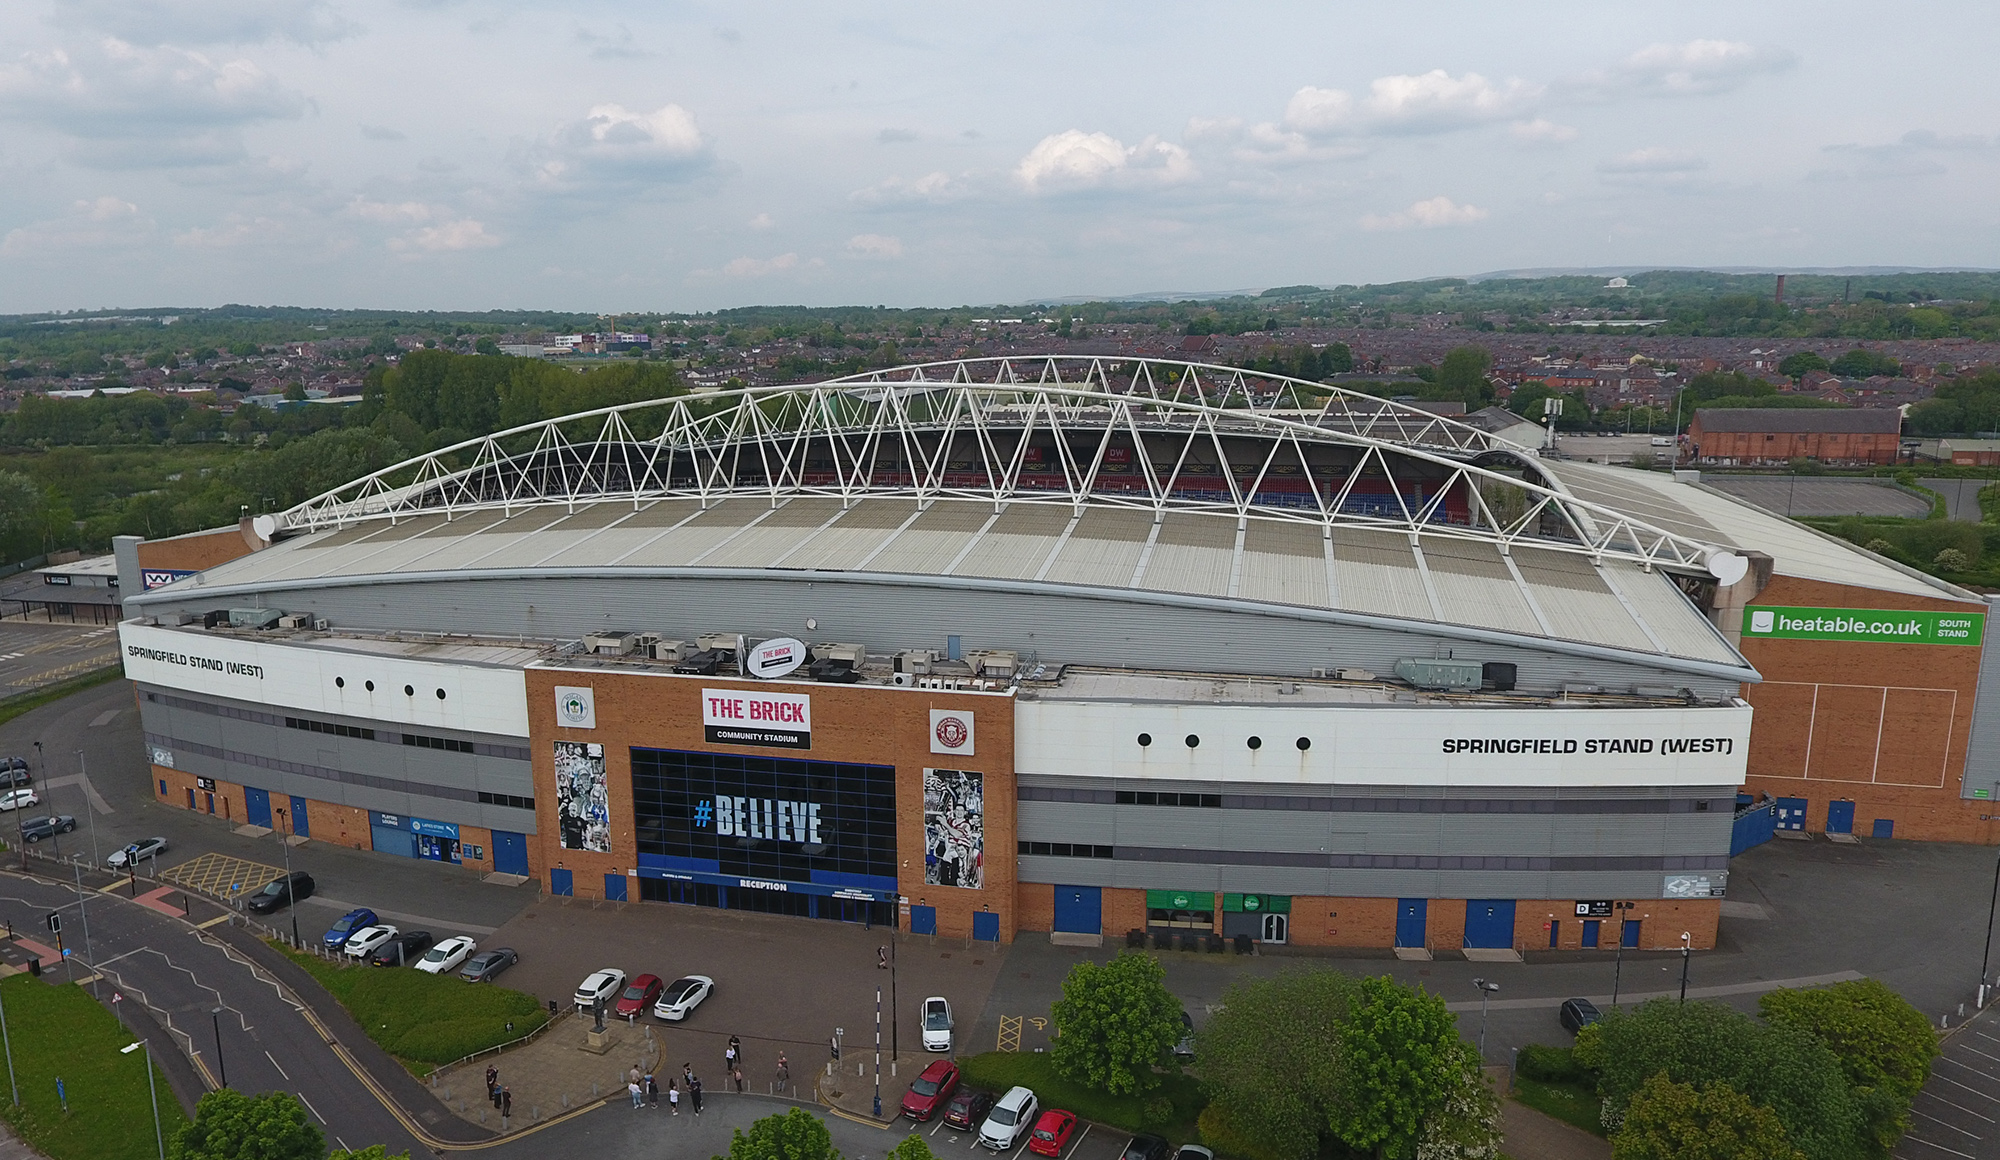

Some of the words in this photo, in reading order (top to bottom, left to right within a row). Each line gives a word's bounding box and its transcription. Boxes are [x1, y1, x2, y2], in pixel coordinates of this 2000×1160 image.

[1109, 449, 1124, 457] DW
[1778, 615, 1922, 636] heatable.co.uk
[1938, 619, 1971, 628] SOUTH
[1937, 629, 1969, 638] STAND
[762, 650, 774, 659] THE
[774, 646, 791, 657] BRICK
[127, 645, 187, 666] SPRINGFIELD
[189, 656, 224, 672] STAND
[226, 661, 264, 680] (WEST)
[708, 697, 744, 719] THE
[750, 700, 805, 723] BRICK
[717, 731, 763, 741] COMMUNITY
[764, 734, 798, 743] STADIUM
[1442, 739, 1578, 755] SPRINGFIELD
[1584, 739, 1654, 754] STAND
[1660, 738, 1733, 756] (WEST)
[1770, 807, 1776, 816] E
[694, 794, 822, 844] #BELIEVE
[740, 879, 788, 892] RECEPTION
[948, 1135, 958, 1144] 2
